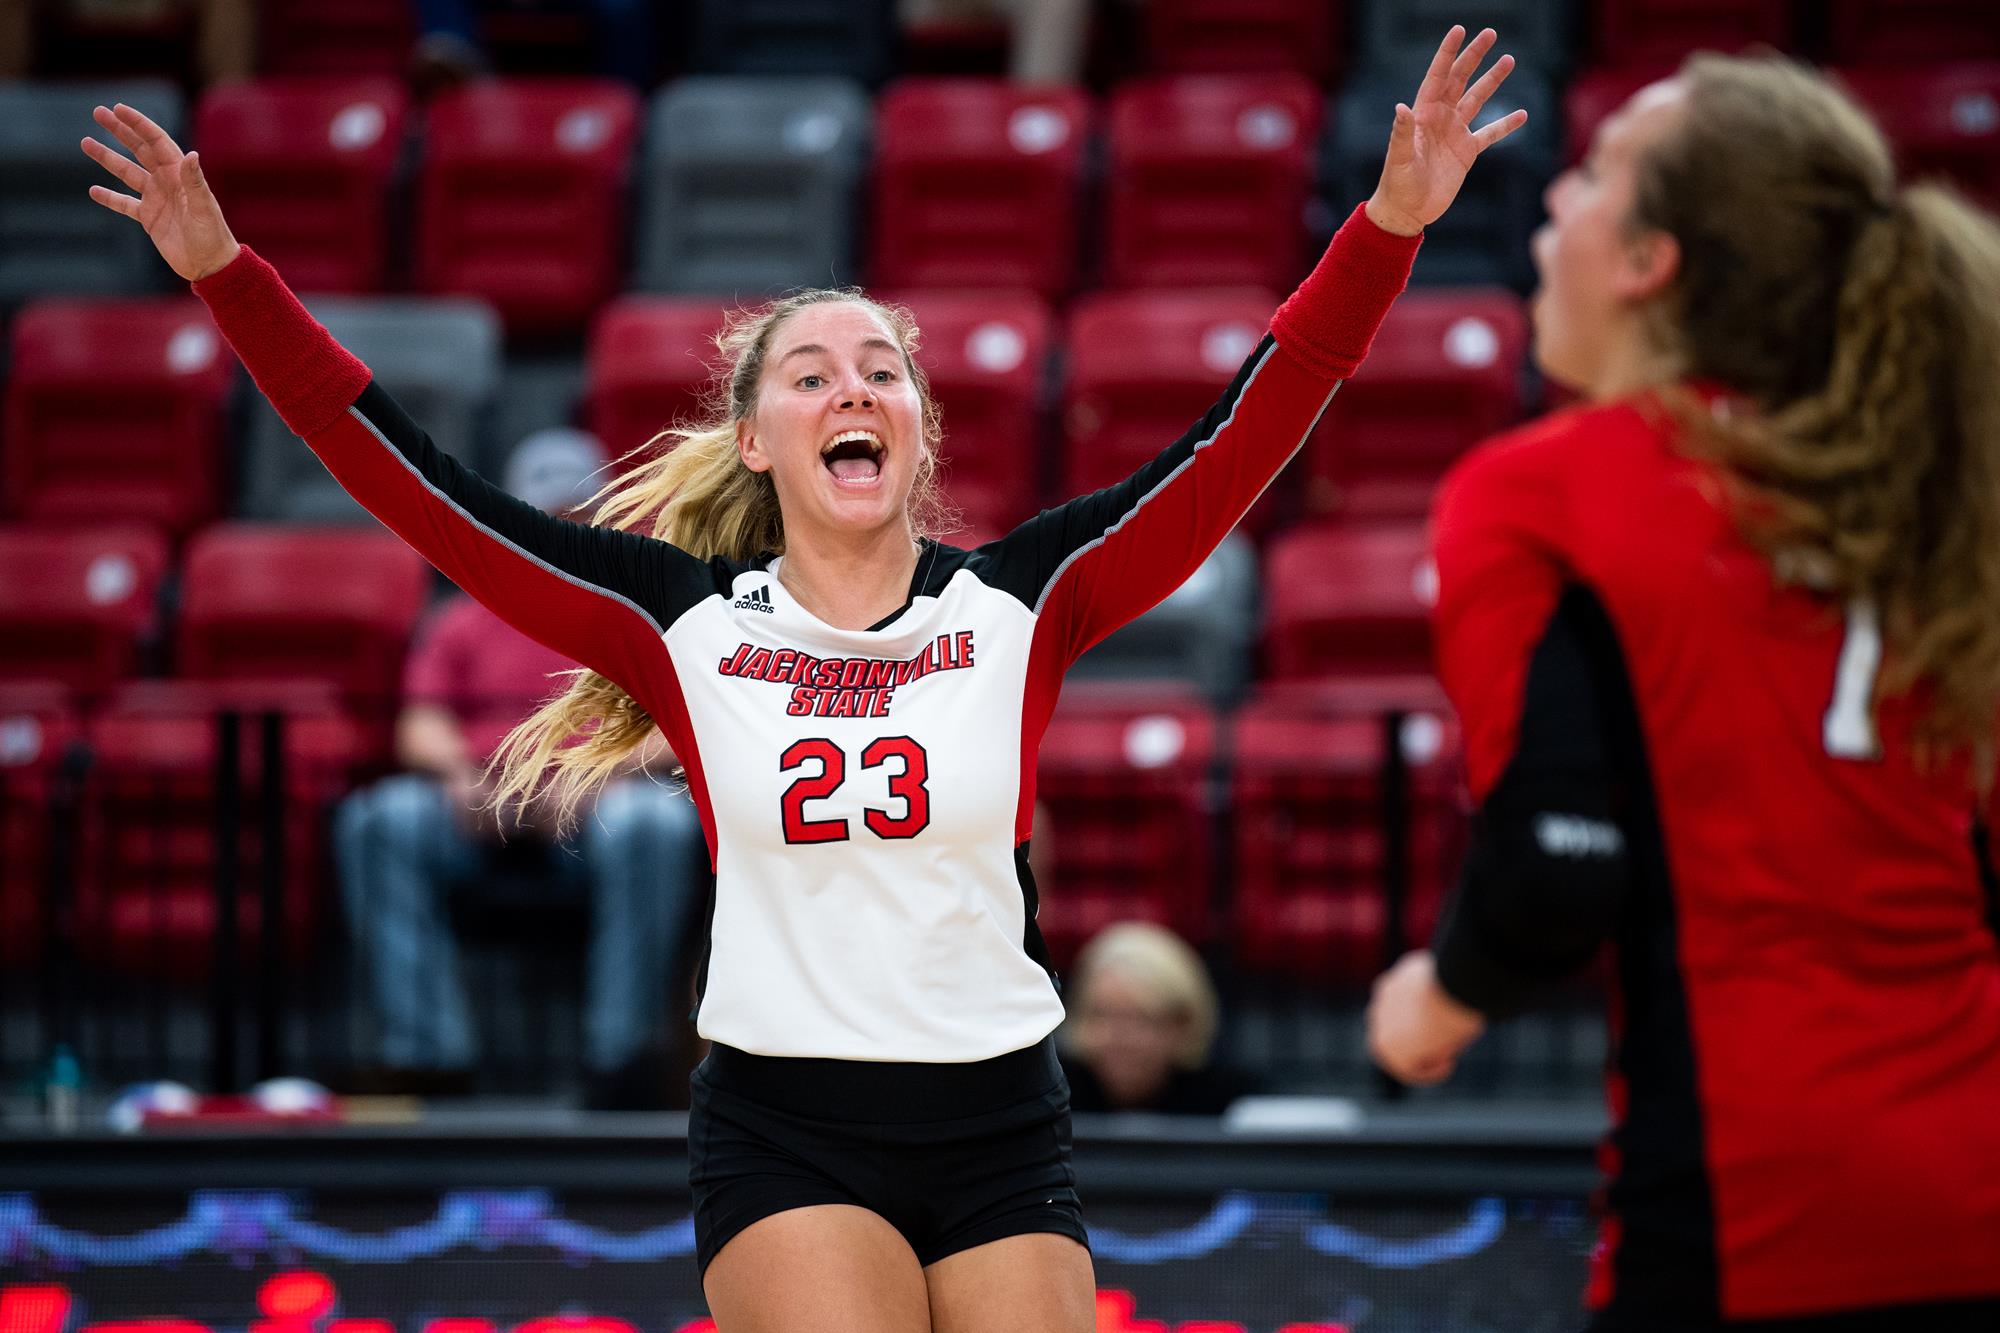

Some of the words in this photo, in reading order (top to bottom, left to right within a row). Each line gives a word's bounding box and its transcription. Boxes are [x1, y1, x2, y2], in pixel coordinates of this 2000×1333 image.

[734, 599, 775, 614] adidas
[719, 630, 975, 687] JACKSONVILLE
[786, 685, 896, 718] STATE
[780, 735, 930, 844] 23
